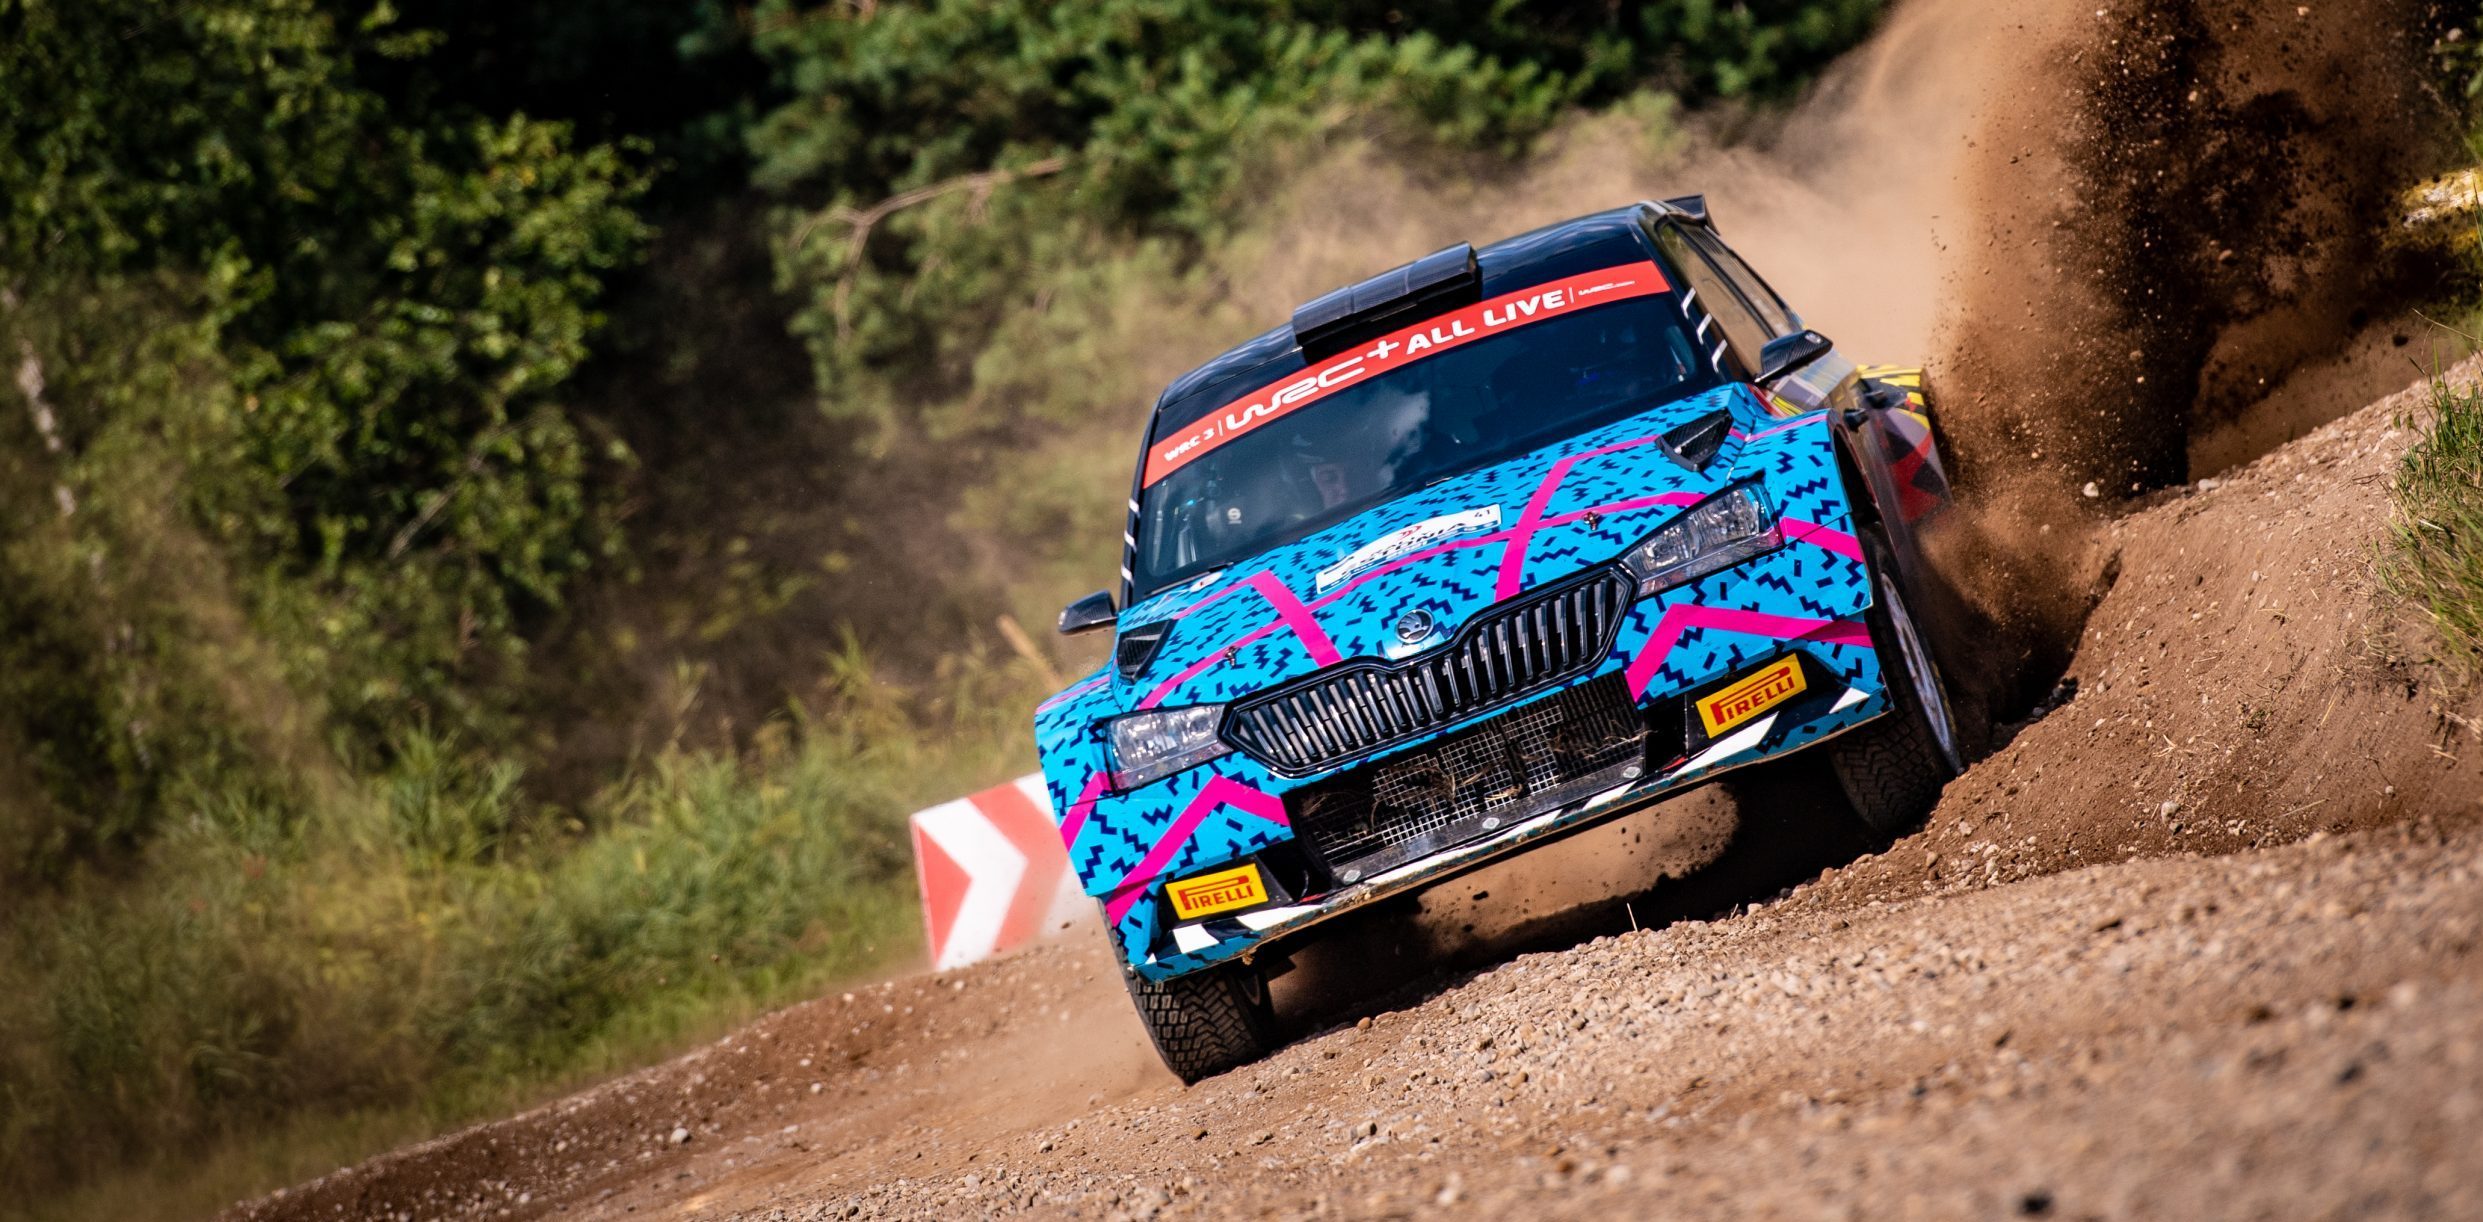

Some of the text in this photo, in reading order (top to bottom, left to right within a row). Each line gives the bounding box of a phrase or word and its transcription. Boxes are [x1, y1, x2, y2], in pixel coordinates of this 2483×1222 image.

[1164, 435, 1201, 462] WRC
[1203, 427, 1215, 440] 3
[1406, 320, 1475, 355] ALL
[1482, 289, 1565, 327] LIVE
[1710, 666, 1795, 726] PIRELLI
[1178, 875, 1254, 911] PIRELLI
